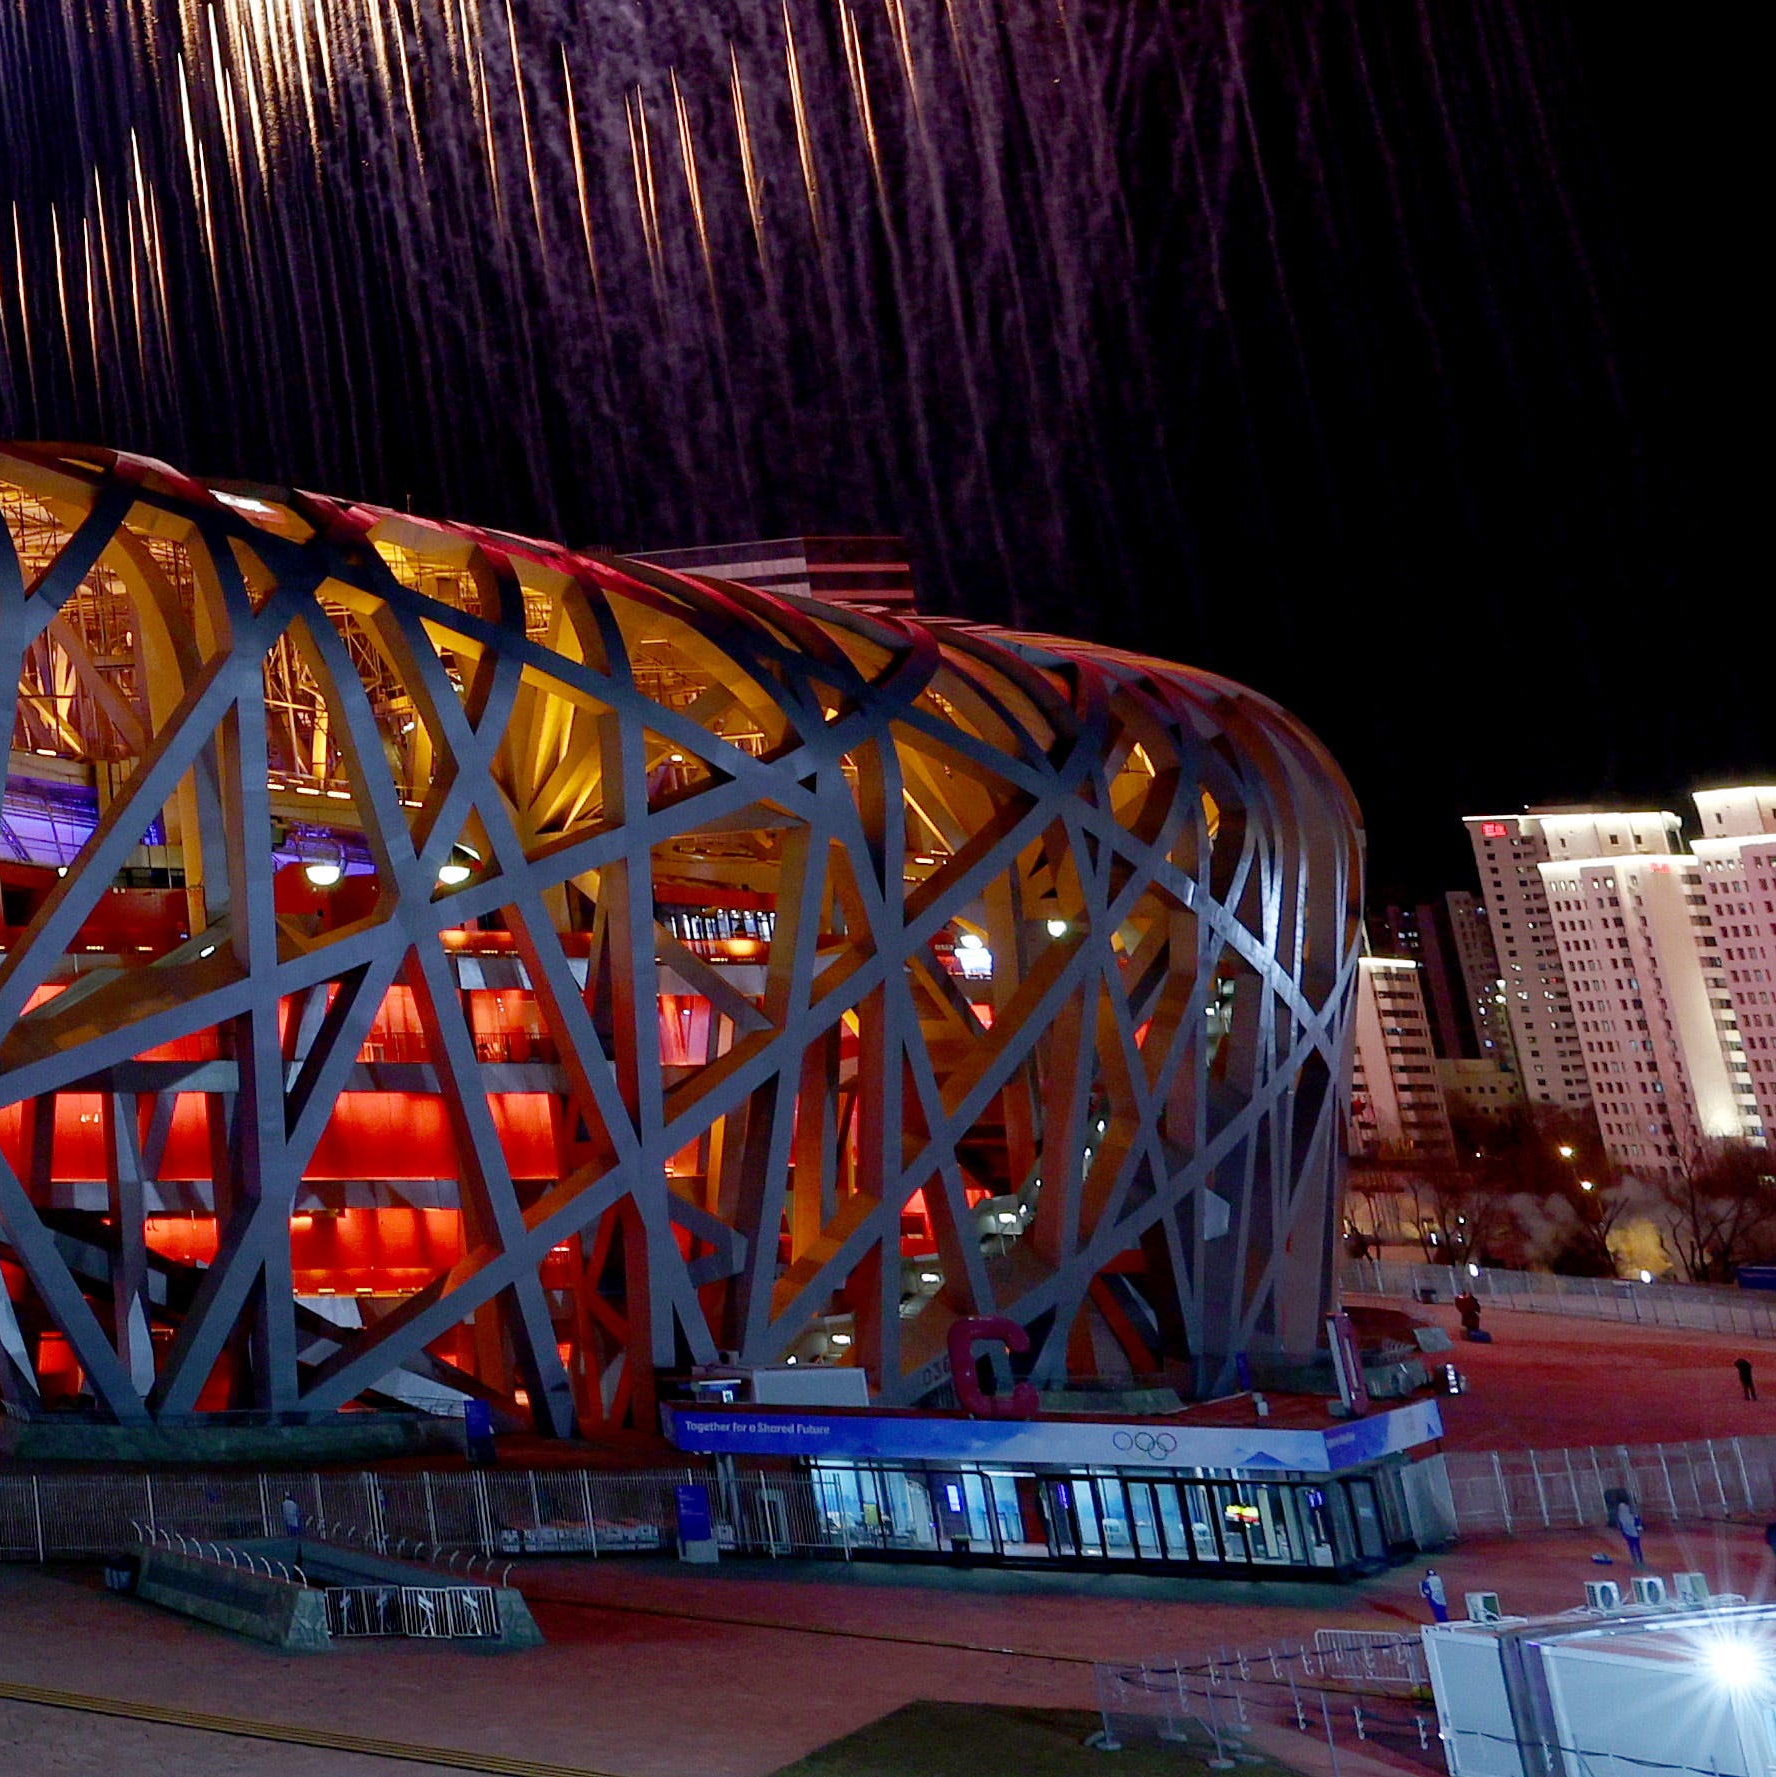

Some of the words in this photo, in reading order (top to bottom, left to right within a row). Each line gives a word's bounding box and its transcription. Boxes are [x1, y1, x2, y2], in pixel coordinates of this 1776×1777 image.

[947, 1315, 1038, 1419] C
[685, 1421, 730, 1434] Together
[733, 1421, 747, 1432] for
[749, 1424, 756, 1433] a
[757, 1422, 794, 1434] Shared
[797, 1423, 830, 1434] Future
